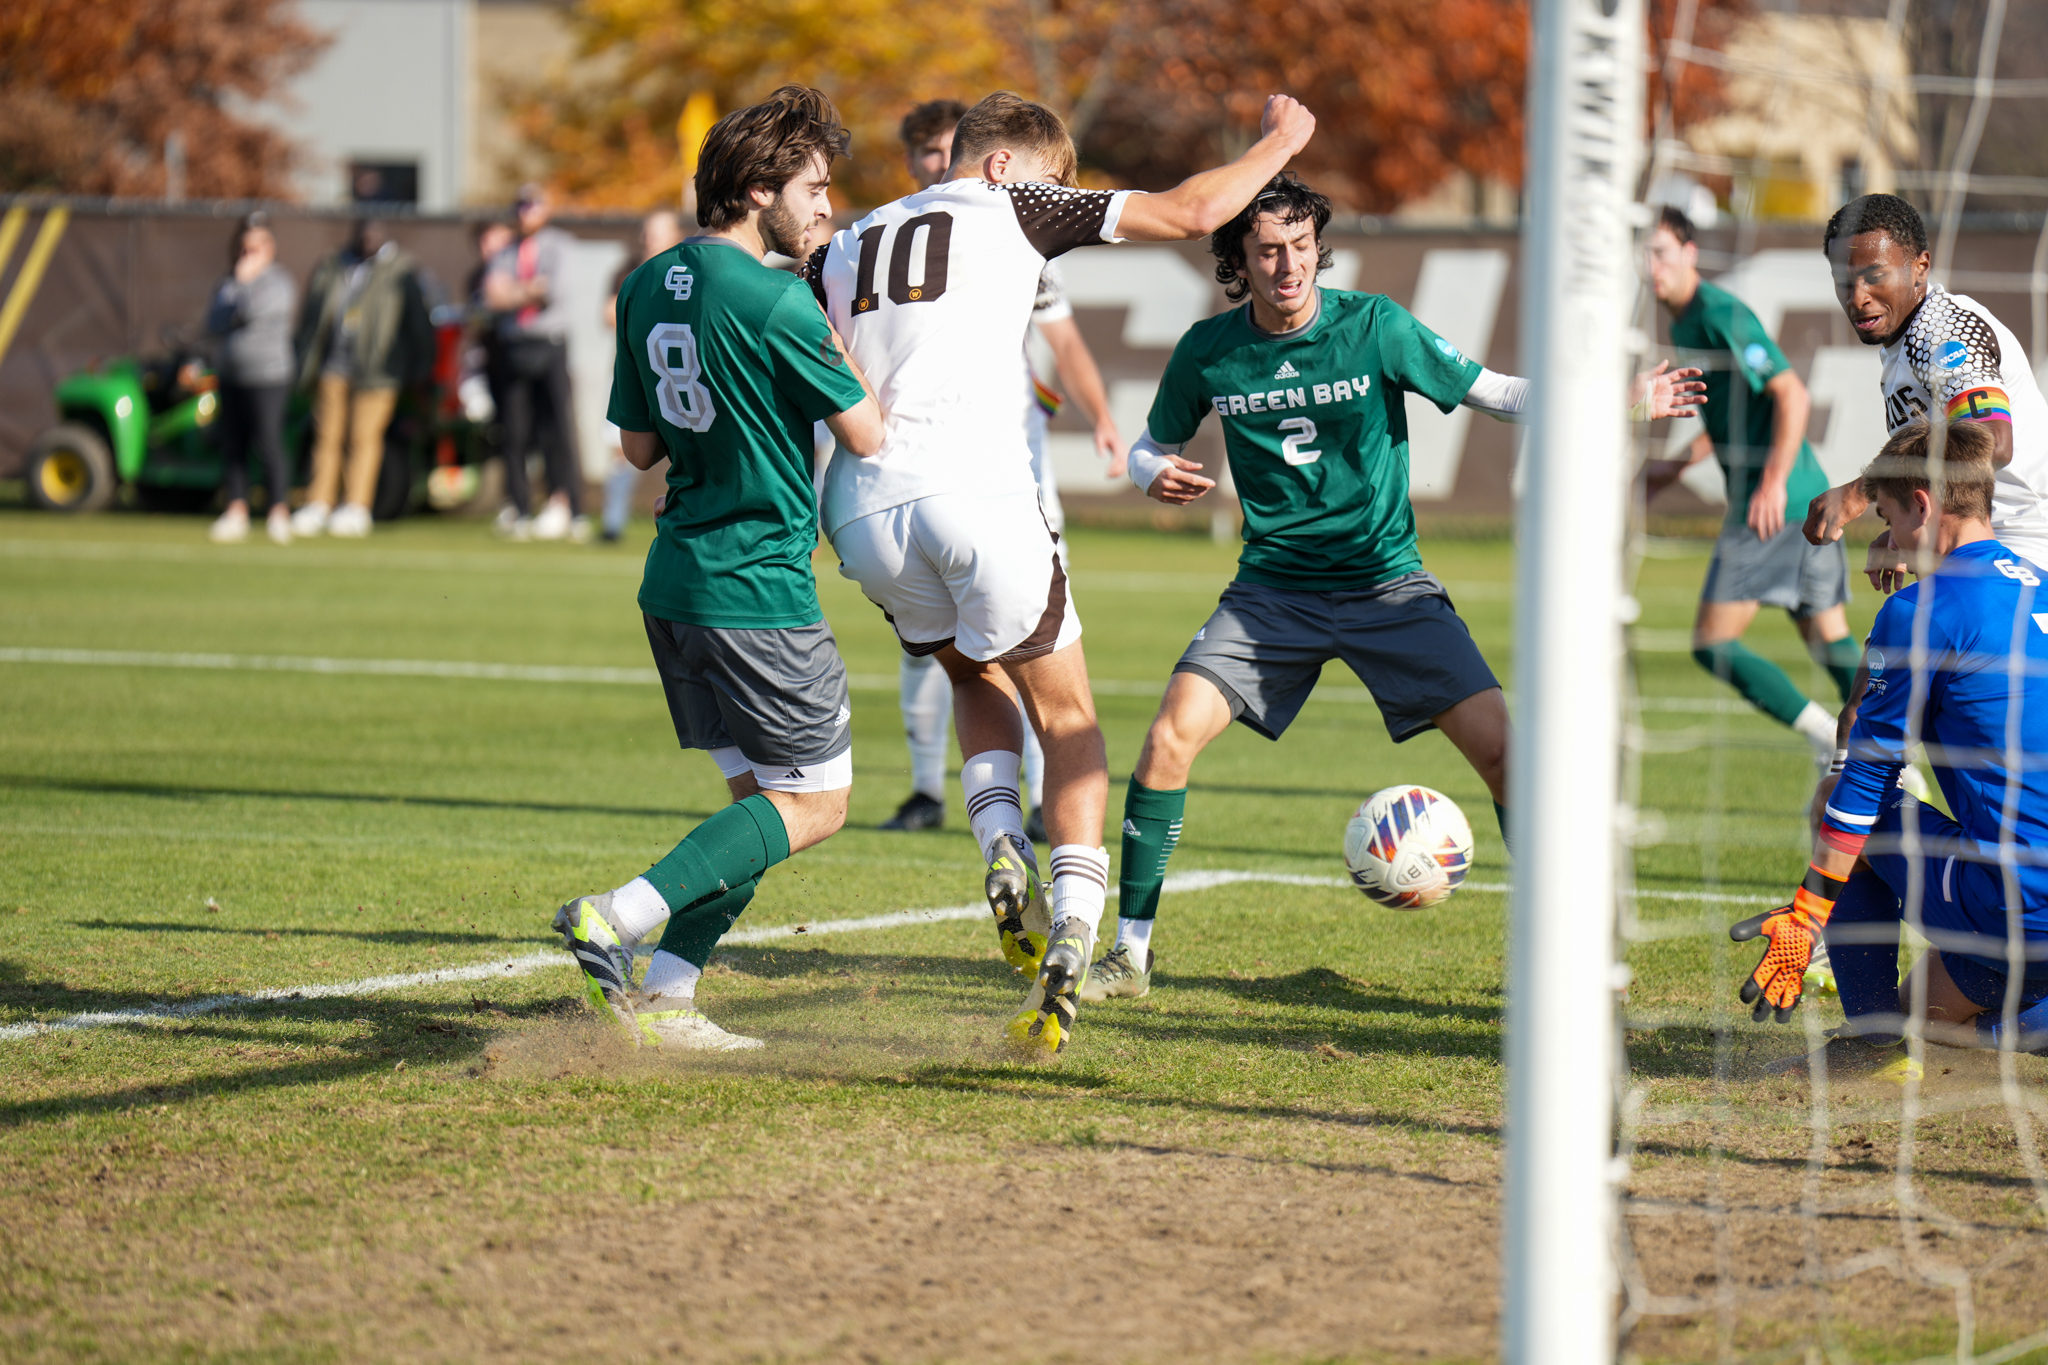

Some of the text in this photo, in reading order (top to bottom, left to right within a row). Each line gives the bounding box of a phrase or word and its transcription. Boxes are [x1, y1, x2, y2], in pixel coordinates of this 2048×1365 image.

[851, 211, 954, 318] 10
[664, 265, 694, 300] GB
[1939, 348, 1967, 366] NCAA
[646, 322, 717, 432] 8
[1274, 371, 1300, 380] adidas
[1212, 374, 1371, 416] GREEN BAY
[1967, 390, 1992, 419] C
[1277, 416, 1322, 466] 2
[1994, 559, 2041, 587] GB
[1869, 661, 1884, 671] NCAA
